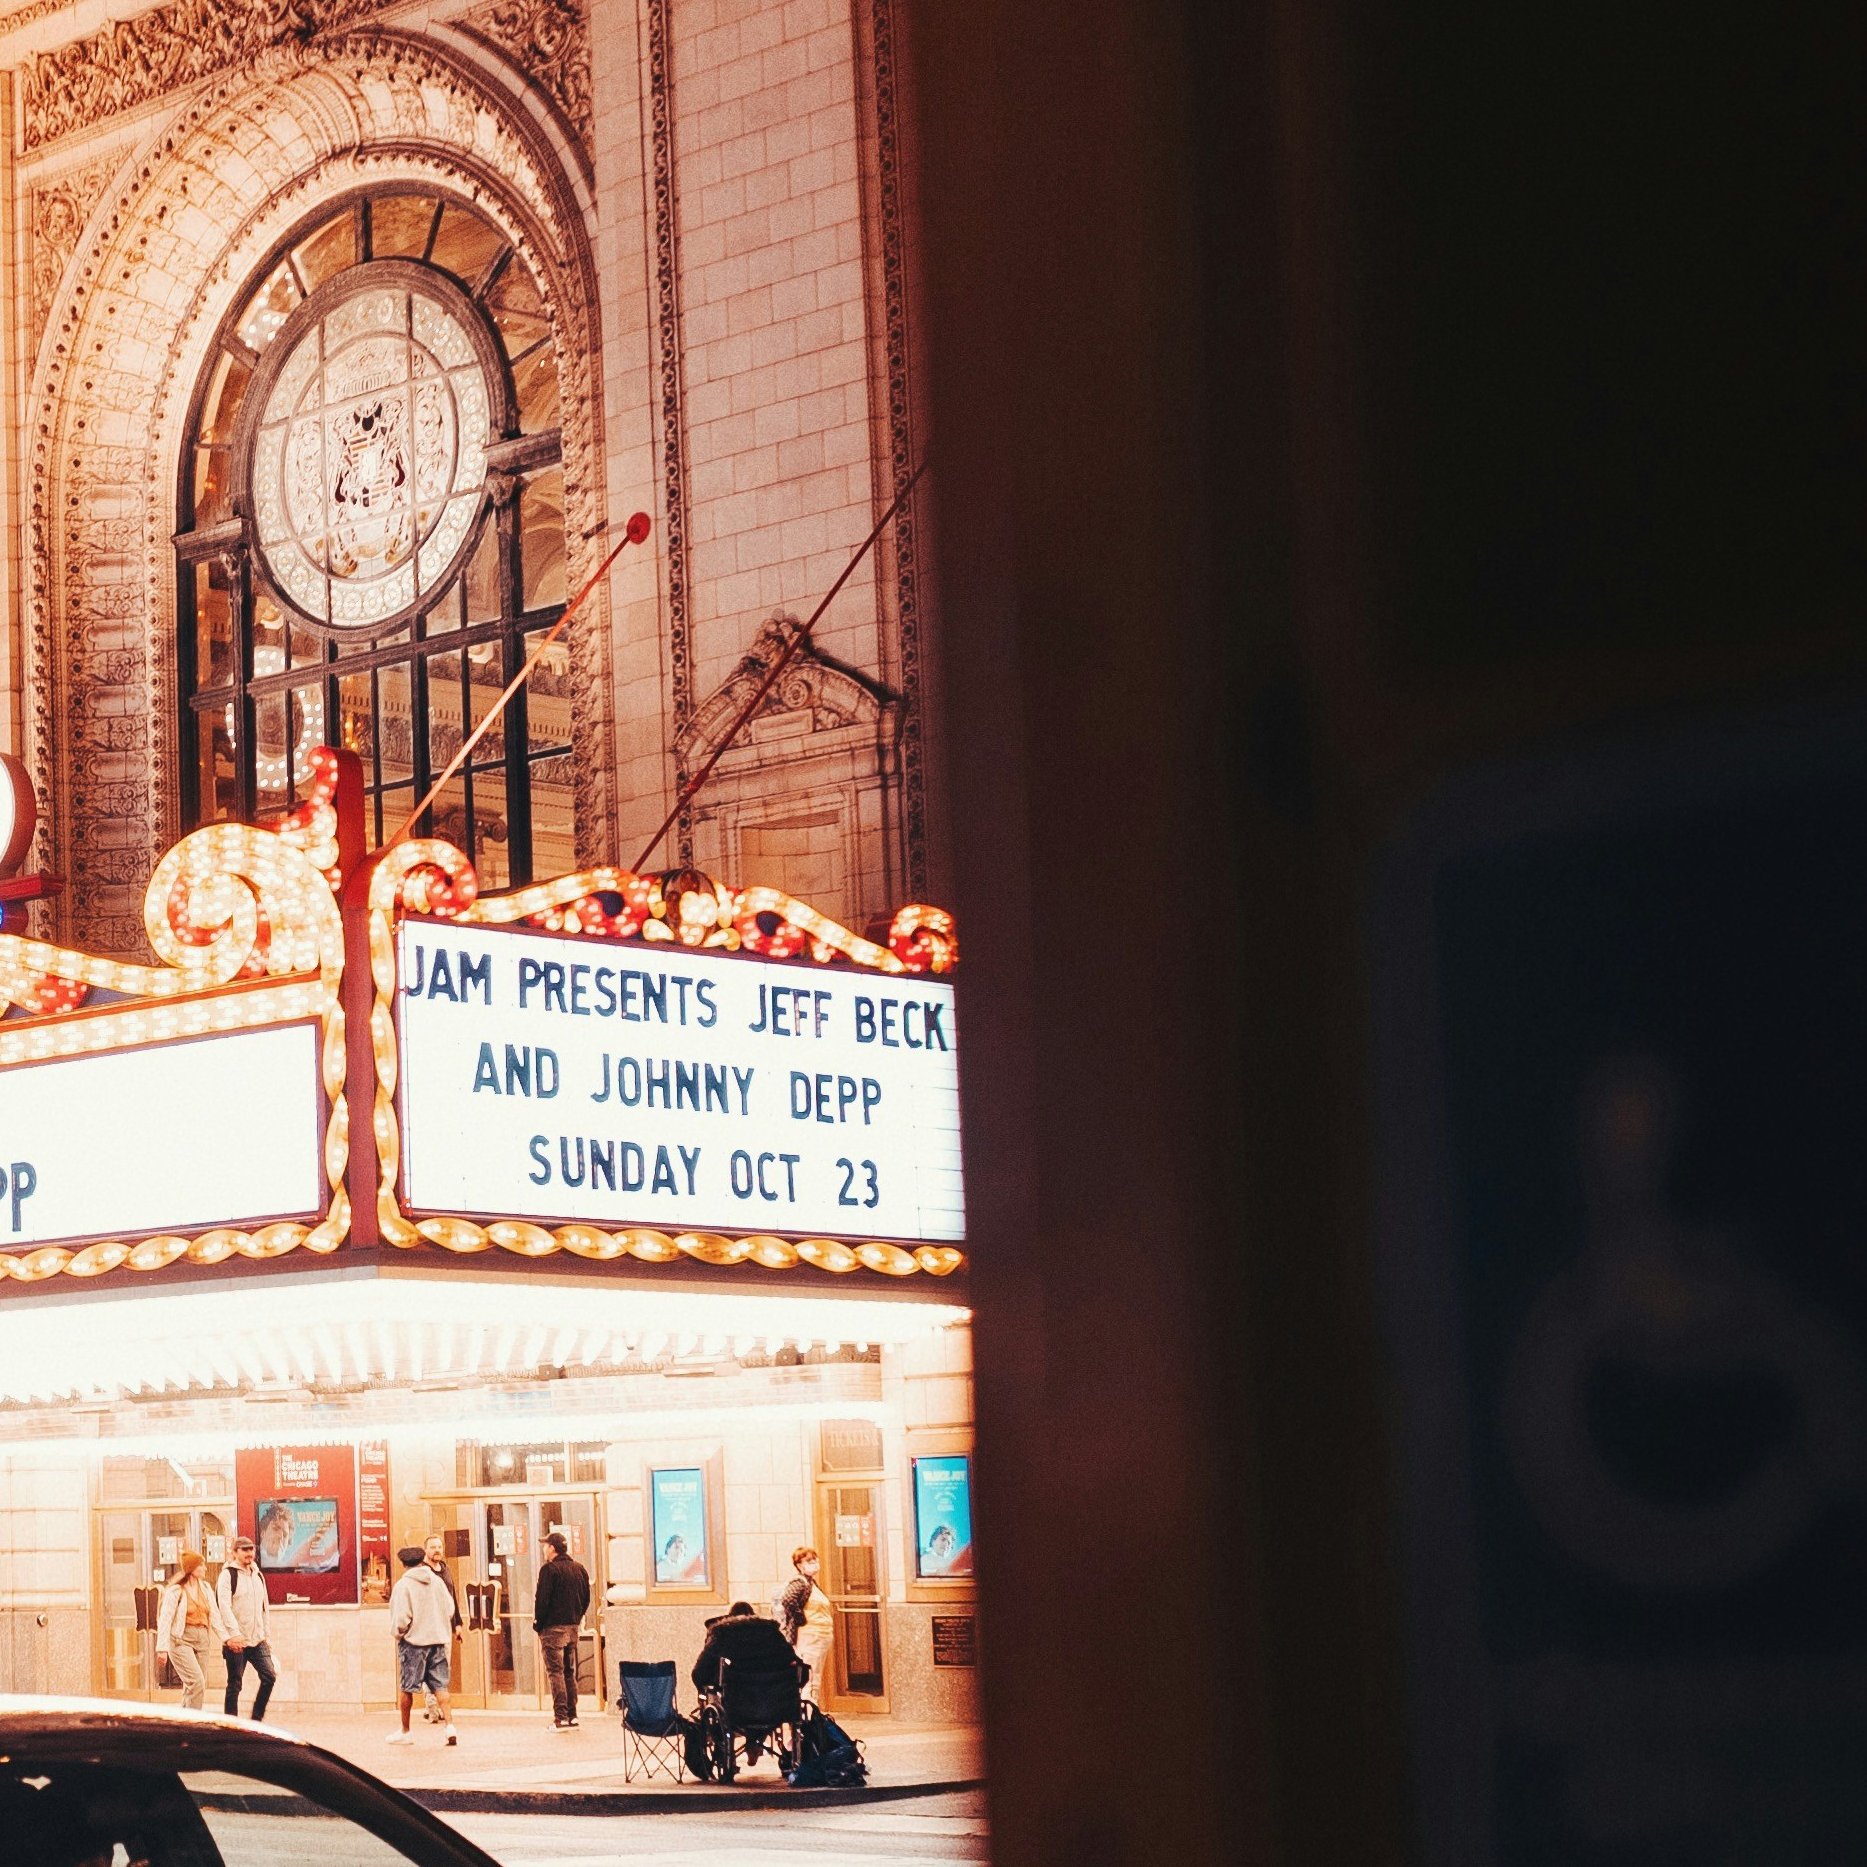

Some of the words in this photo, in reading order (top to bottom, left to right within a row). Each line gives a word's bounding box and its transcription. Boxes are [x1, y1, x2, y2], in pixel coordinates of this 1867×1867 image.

[406, 944, 492, 1005] JAM
[519, 957, 718, 1029] PRESENTS
[749, 983, 832, 1038] JEFF
[855, 996, 949, 1052] BECK
[473, 1041, 560, 1099] AND
[591, 1053, 754, 1116] JOHNNY
[790, 1070, 882, 1125] DEPP
[528, 1134, 701, 1197] SUNDAY
[731, 1150, 801, 1203] OCT
[835, 1157, 879, 1209] 23
[282, 1460, 319, 1471] CHICAGO
[282, 1470, 319, 1481] THEATRE
